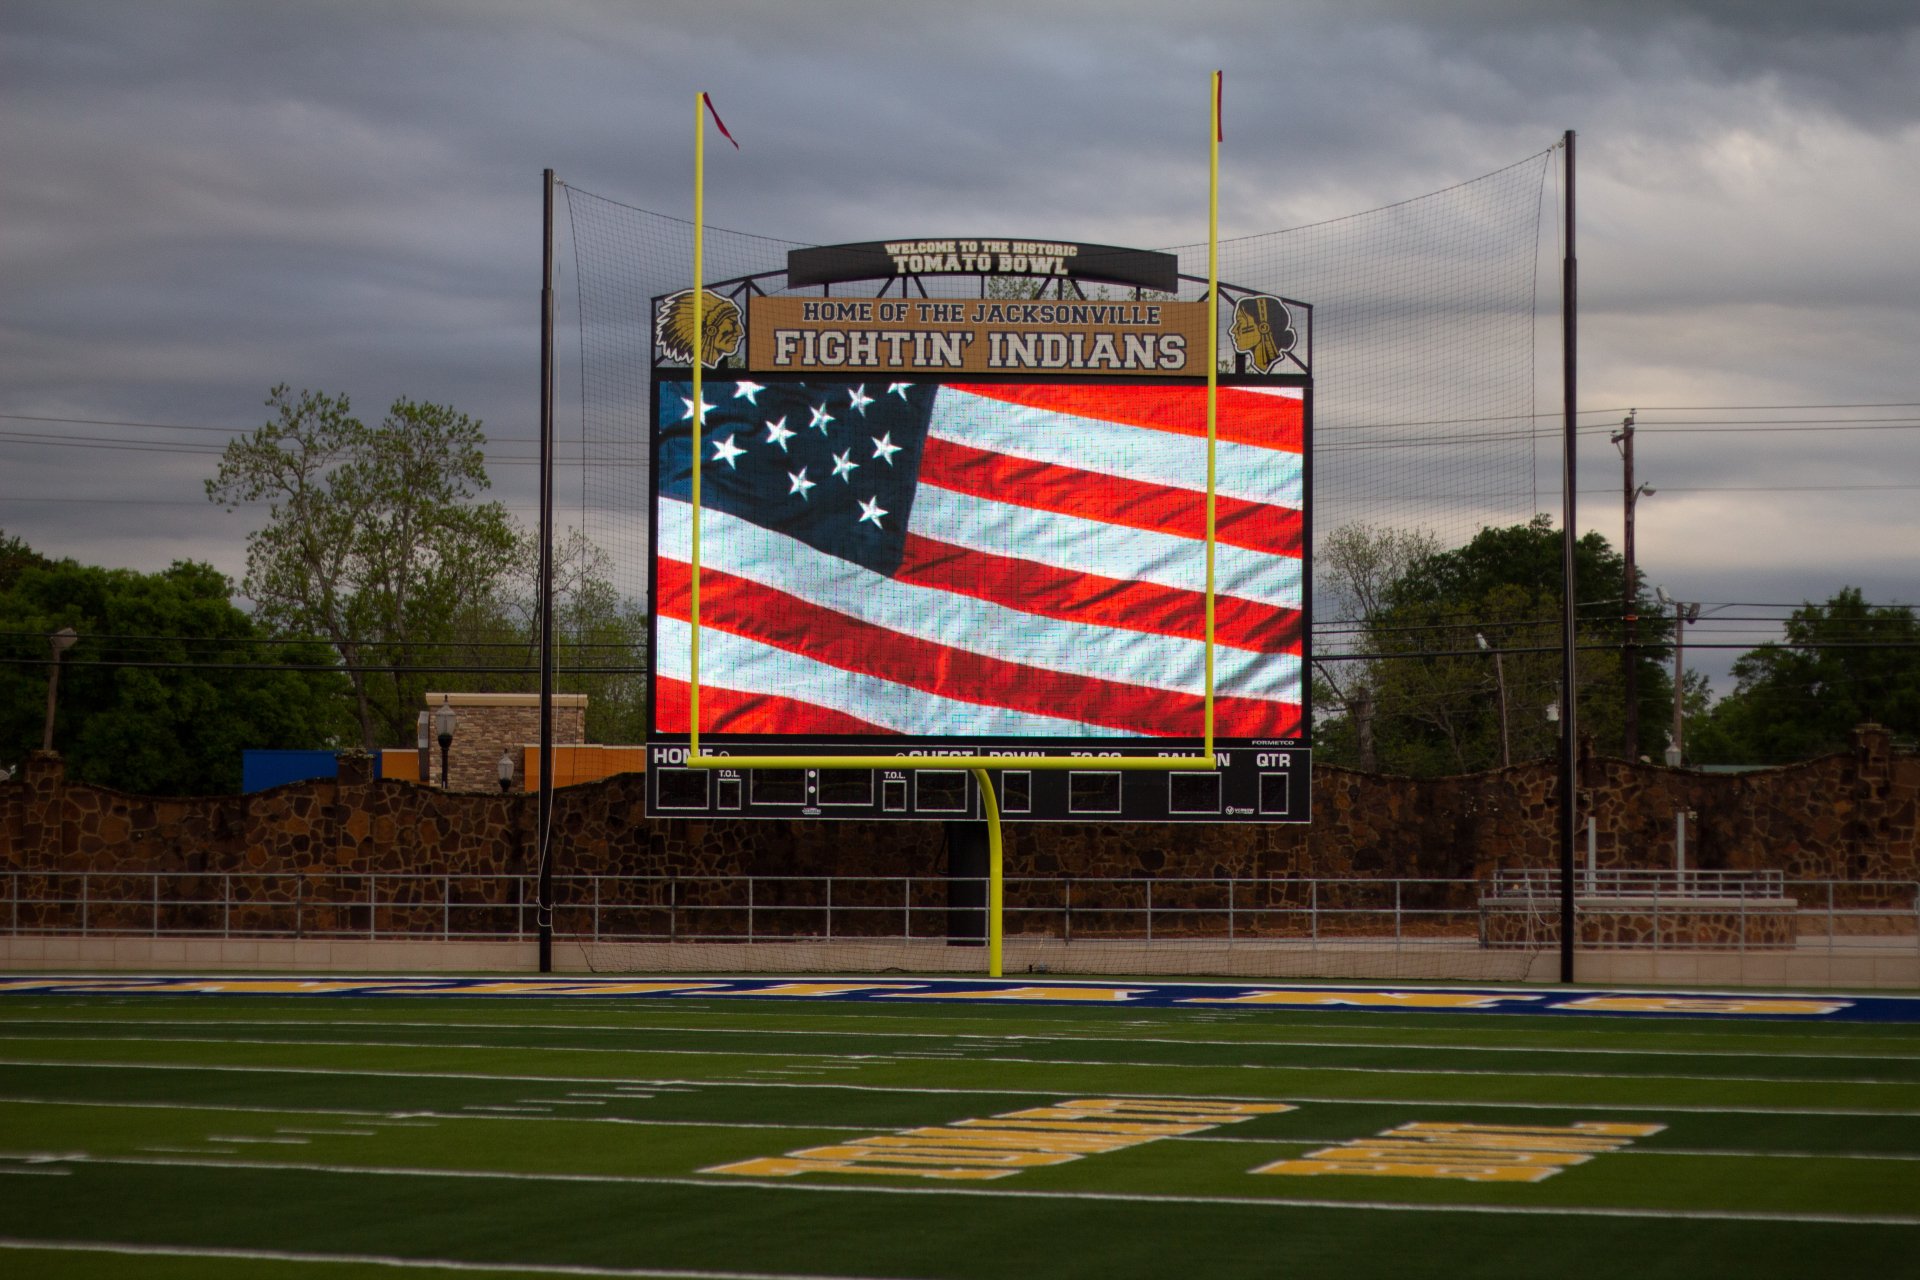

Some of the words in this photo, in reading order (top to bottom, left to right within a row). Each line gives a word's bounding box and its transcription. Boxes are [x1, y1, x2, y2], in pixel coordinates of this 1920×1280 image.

[884, 241, 956, 255] WELCOME
[959, 241, 978, 253] TO
[981, 241, 1010, 254] THE
[1012, 242, 1078, 257] HISTORIC
[893, 254, 991, 273] TOMATO
[998, 255, 1068, 275] BOWL
[803, 302, 874, 322] HOME
[879, 303, 910, 322] OF
[917, 304, 965, 323] THE
[971, 304, 1161, 325] JACKSONVILLE
[774, 329, 975, 367] FIGHTIN'
[988, 331, 1188, 371] INDIANS
[1256, 753, 1291, 767] QTR
[718, 769, 740, 778] T.O.L.
[884, 771, 906, 779] T.O.L.
